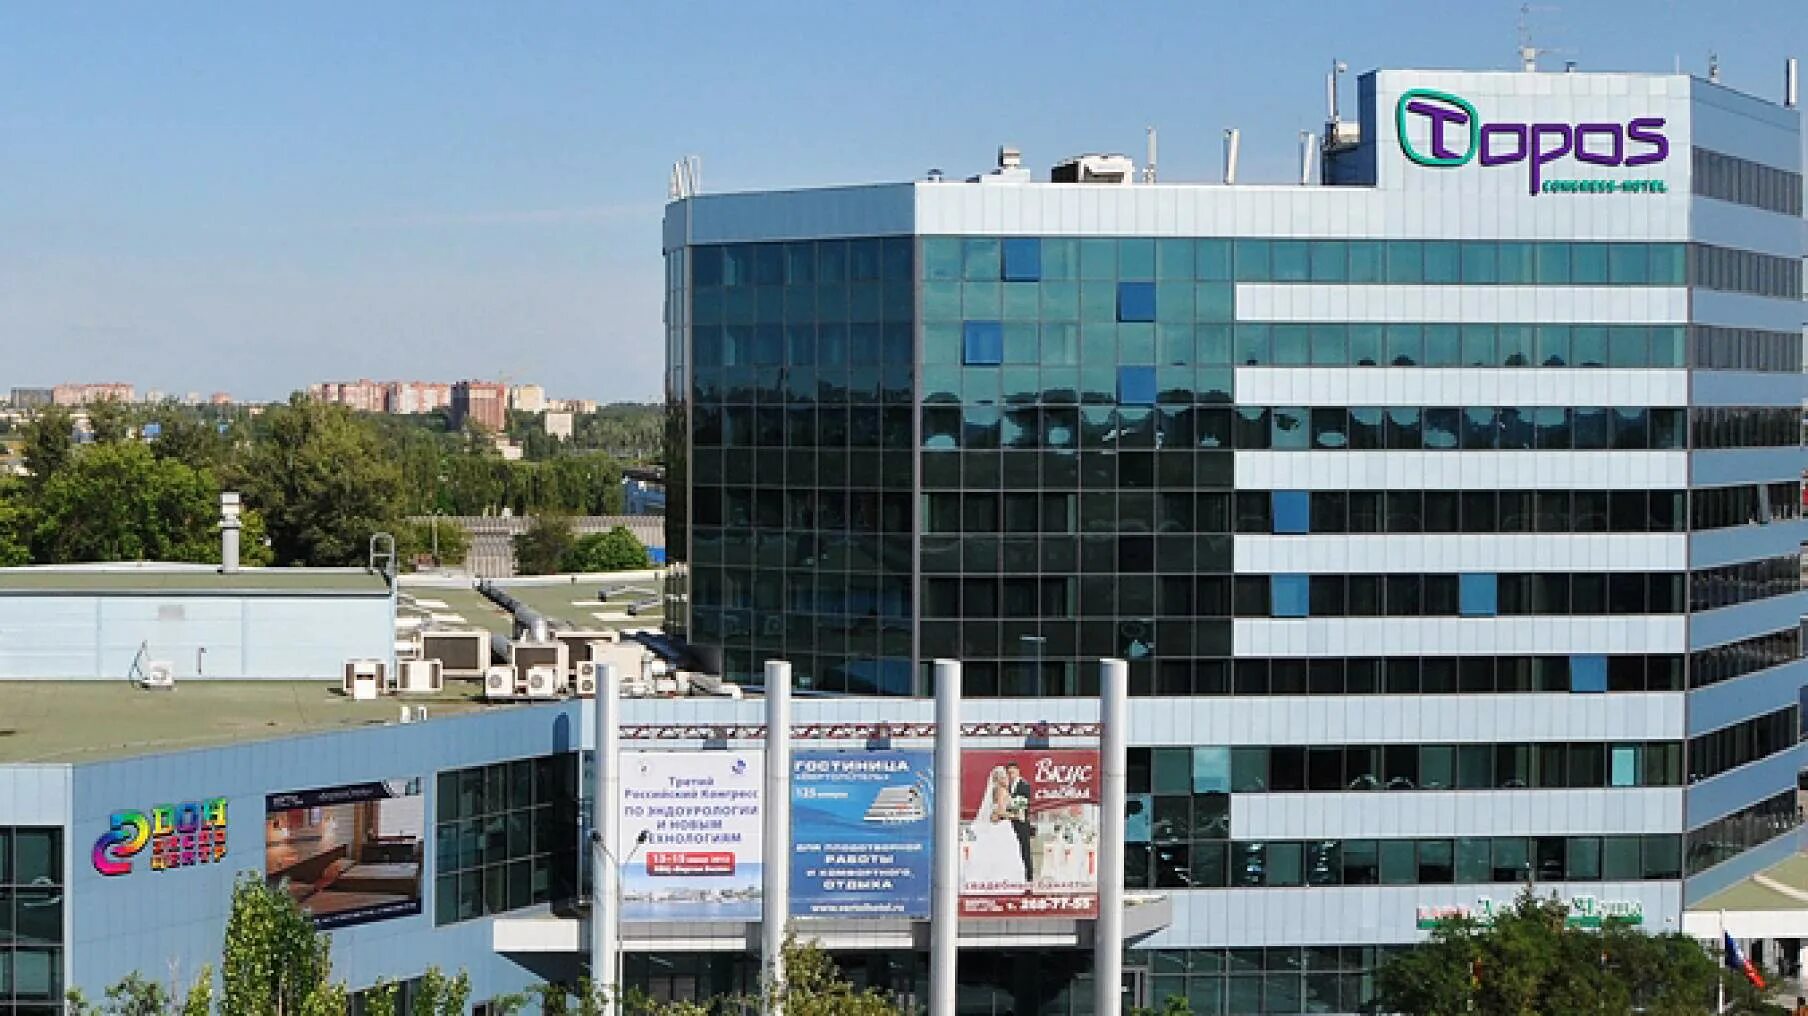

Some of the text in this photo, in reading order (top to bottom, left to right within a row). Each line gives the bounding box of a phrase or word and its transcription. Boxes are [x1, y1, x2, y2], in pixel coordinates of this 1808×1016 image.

[1397, 89, 1669, 195] Topos
[794, 760, 910, 773] ГОСТИНИЦА
[1035, 757, 1093, 786] Вкус
[152, 797, 227, 836] ДОН
[624, 805, 645, 816] ПО
[642, 832, 741, 844] ЕХНОЛОГИЯМ
[825, 854, 894, 864] РАБОТЫ
[823, 880, 893, 890] ОТДЫХА
